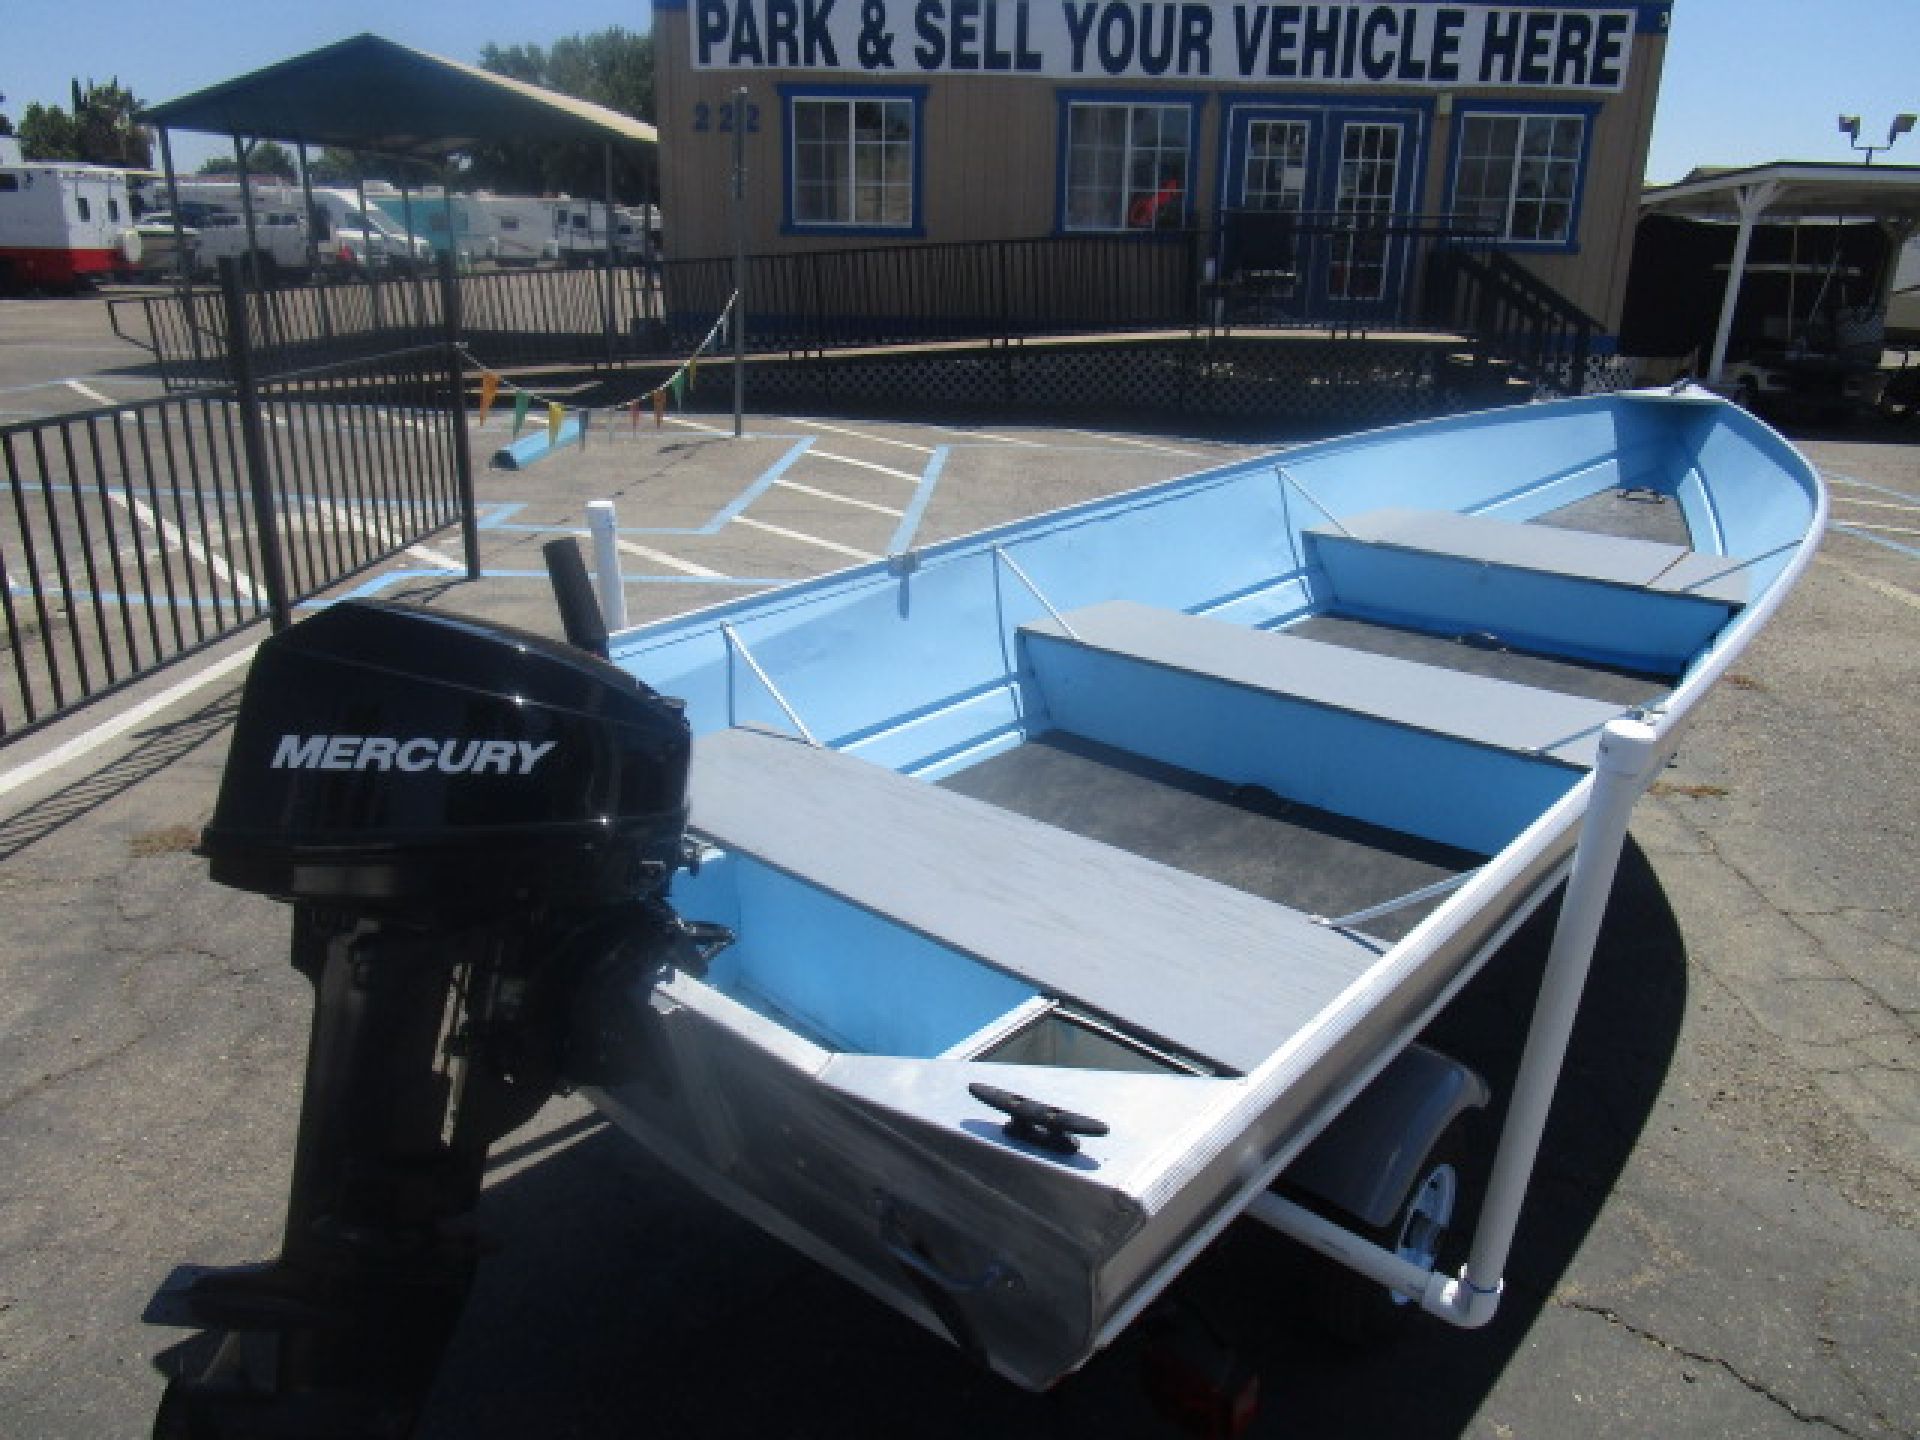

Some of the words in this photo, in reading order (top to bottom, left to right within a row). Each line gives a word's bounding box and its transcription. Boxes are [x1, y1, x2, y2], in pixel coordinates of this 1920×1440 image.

[700, 0, 839, 67] PARK
[857, 0, 895, 69] &
[914, 0, 1042, 70] SELL
[1064, 2, 1211, 75] YOUR
[1235, 5, 1465, 81] VEHICLE
[1479, 13, 1630, 85] HERE
[271, 735, 556, 775] MERCURY
